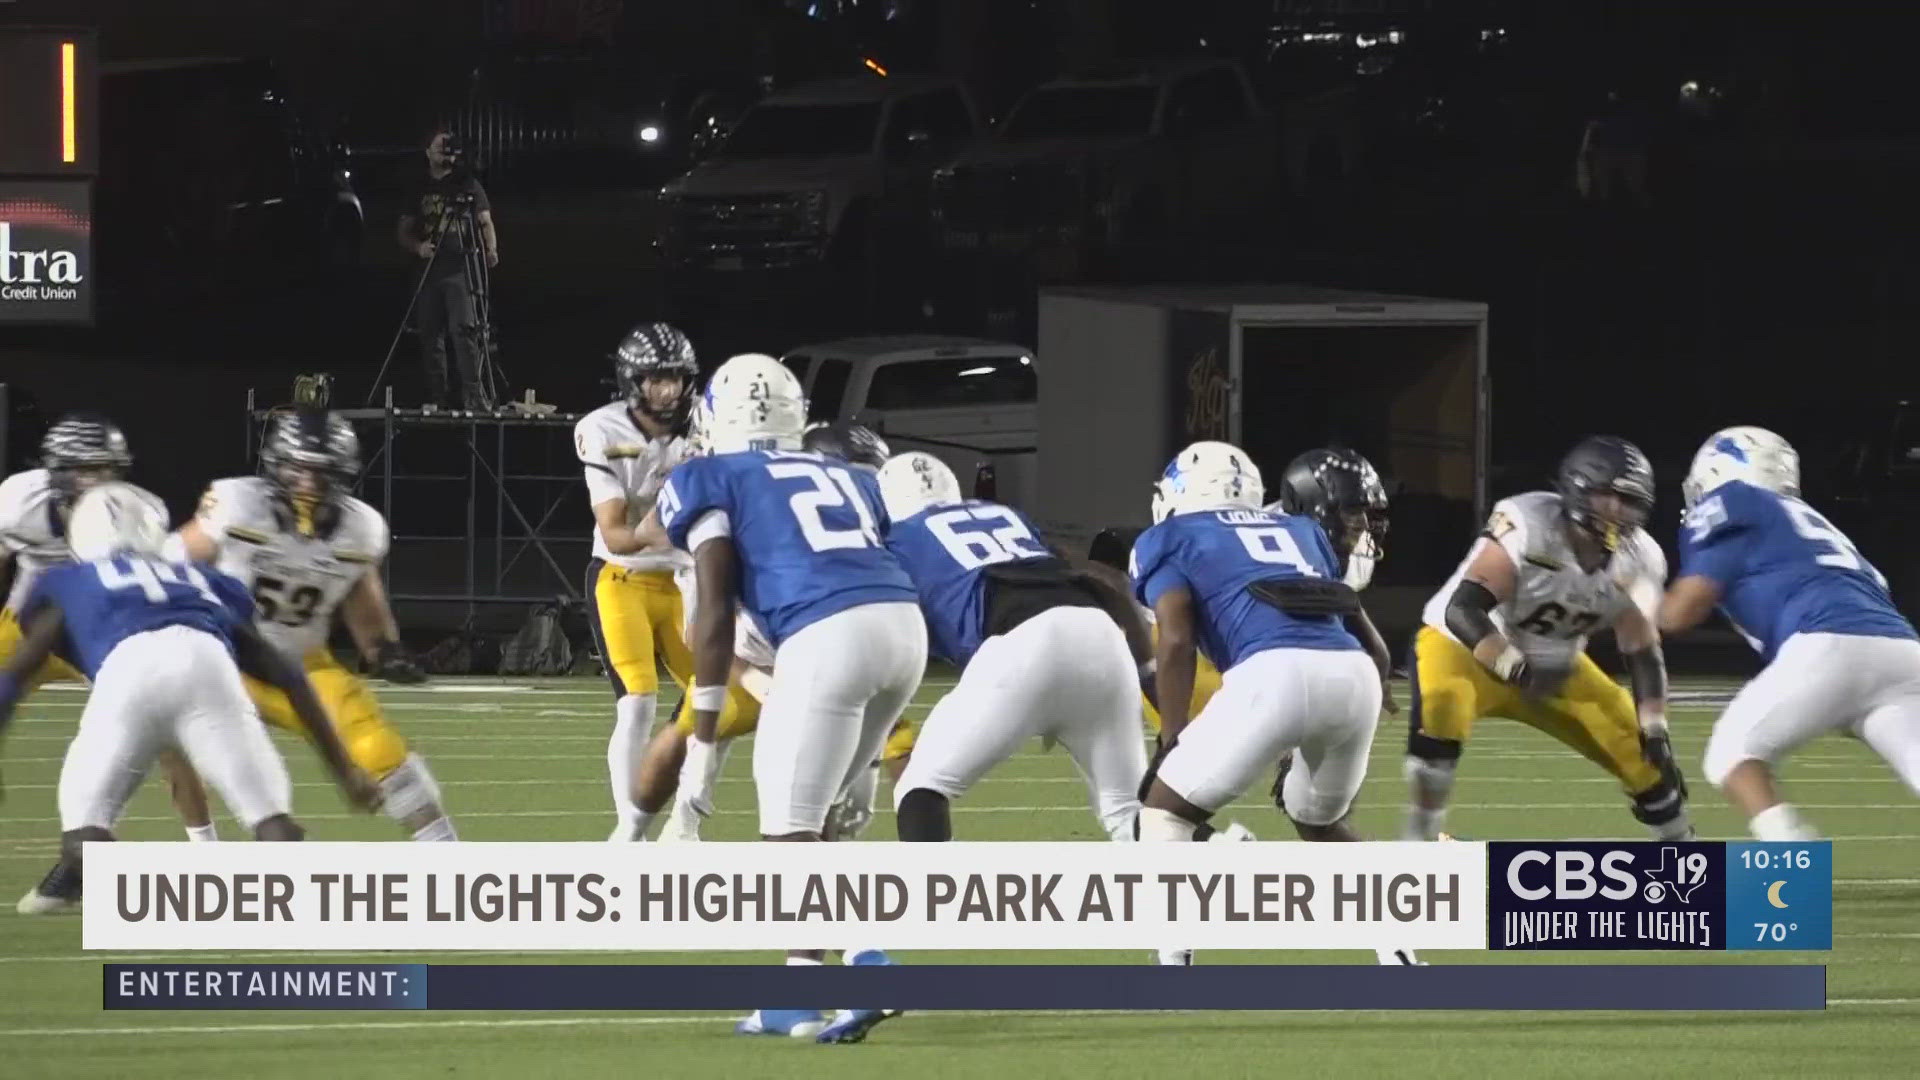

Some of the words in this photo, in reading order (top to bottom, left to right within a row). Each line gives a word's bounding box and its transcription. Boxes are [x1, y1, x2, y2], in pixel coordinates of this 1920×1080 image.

[1, 285, 37, 301] Credit
[40, 285, 77, 301] Union
[749, 381, 770, 400] 21
[656, 479, 682, 529] 21
[764, 463, 885, 554] 21
[924, 504, 1055, 571] 62
[1234, 526, 1322, 578] 9
